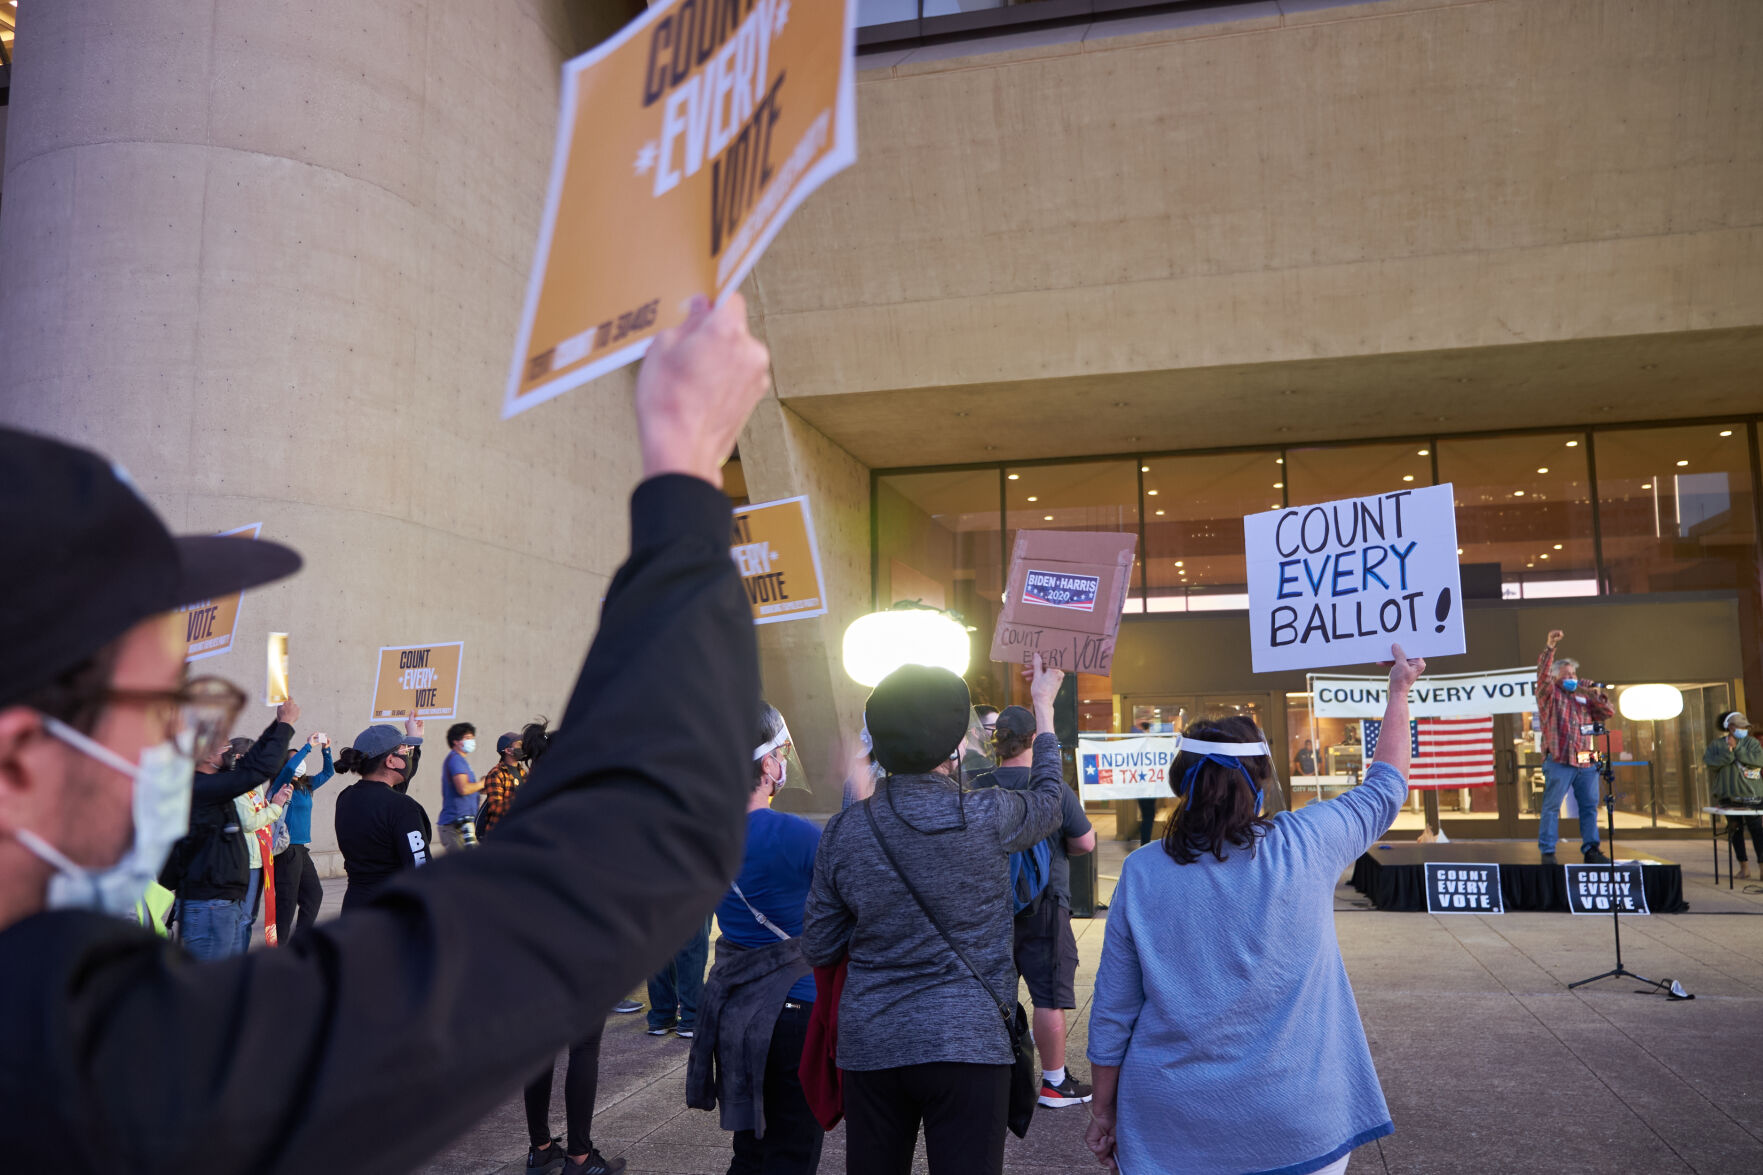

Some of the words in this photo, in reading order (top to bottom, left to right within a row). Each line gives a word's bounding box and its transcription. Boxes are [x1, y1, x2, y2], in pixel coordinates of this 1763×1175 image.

[642, 0, 753, 108] COUN
[653, 0, 777, 198] EVERY
[710, 68, 787, 259] VOTE
[1276, 490, 1411, 558] COUNT
[1277, 541, 1417, 600] EVERY
[744, 571, 788, 604] VOTE
[1028, 574, 1057, 588] BIDEN
[1060, 577, 1096, 592] HARRIS
[1047, 589, 1070, 601] 2020
[186, 605, 218, 642] VOTE
[1001, 628, 1043, 648] COUNT
[399, 649, 431, 669] COUNT
[1074, 635, 1111, 671] VOTE
[403, 668, 435, 690] EVERY
[415, 688, 437, 708] VOTE
[1407, 685, 1475, 703] EVERY
[1437, 870, 1488, 881] COUNT
[1578, 872, 1630, 882] COUNT
[1438, 881, 1488, 893] EVERY
[1579, 883, 1631, 895] EVERY
[1439, 894, 1490, 908] VOTE
